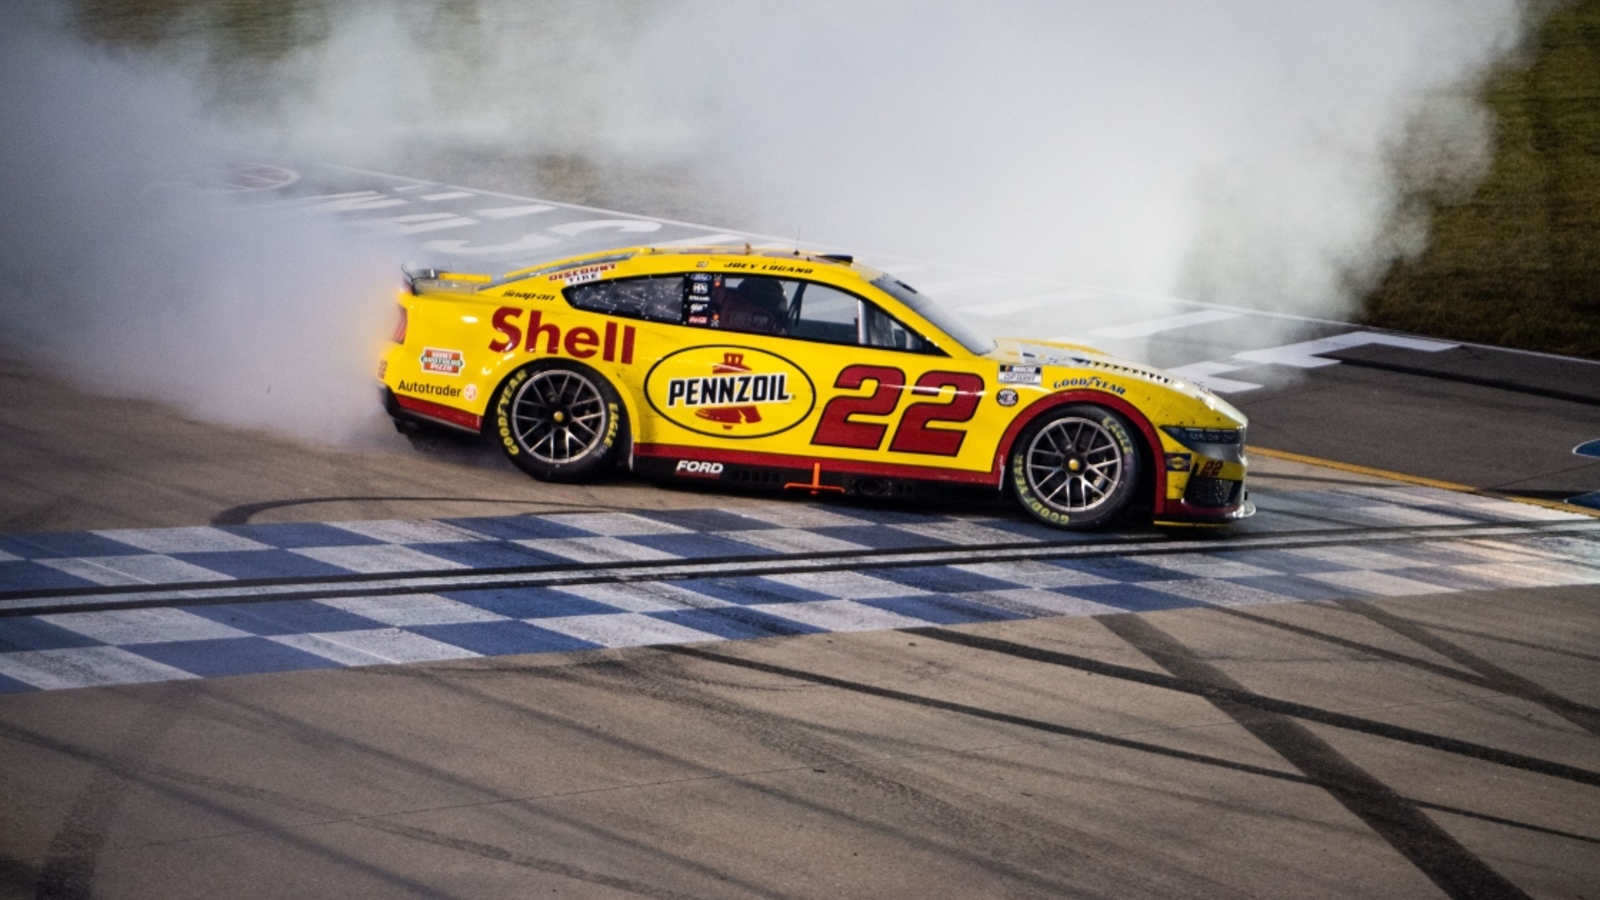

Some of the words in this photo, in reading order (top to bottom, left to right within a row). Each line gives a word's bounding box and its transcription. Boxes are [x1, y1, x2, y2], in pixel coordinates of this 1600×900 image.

[548, 263, 617, 281] DISCOUNT
[724, 262, 758, 270] JOEY
[761, 264, 814, 274] LOGANO
[569, 273, 598, 283] TIRE
[488, 306, 637, 366] Shell
[398, 379, 462, 398] Autotrader
[667, 374, 790, 407] PENNZOIL
[809, 363, 985, 458] 22
[604, 402, 619, 448] EAGLE
[1102, 416, 1134, 455] EAGLE
[676, 460, 724, 474] FORD
[1201, 461, 1224, 477] 22
